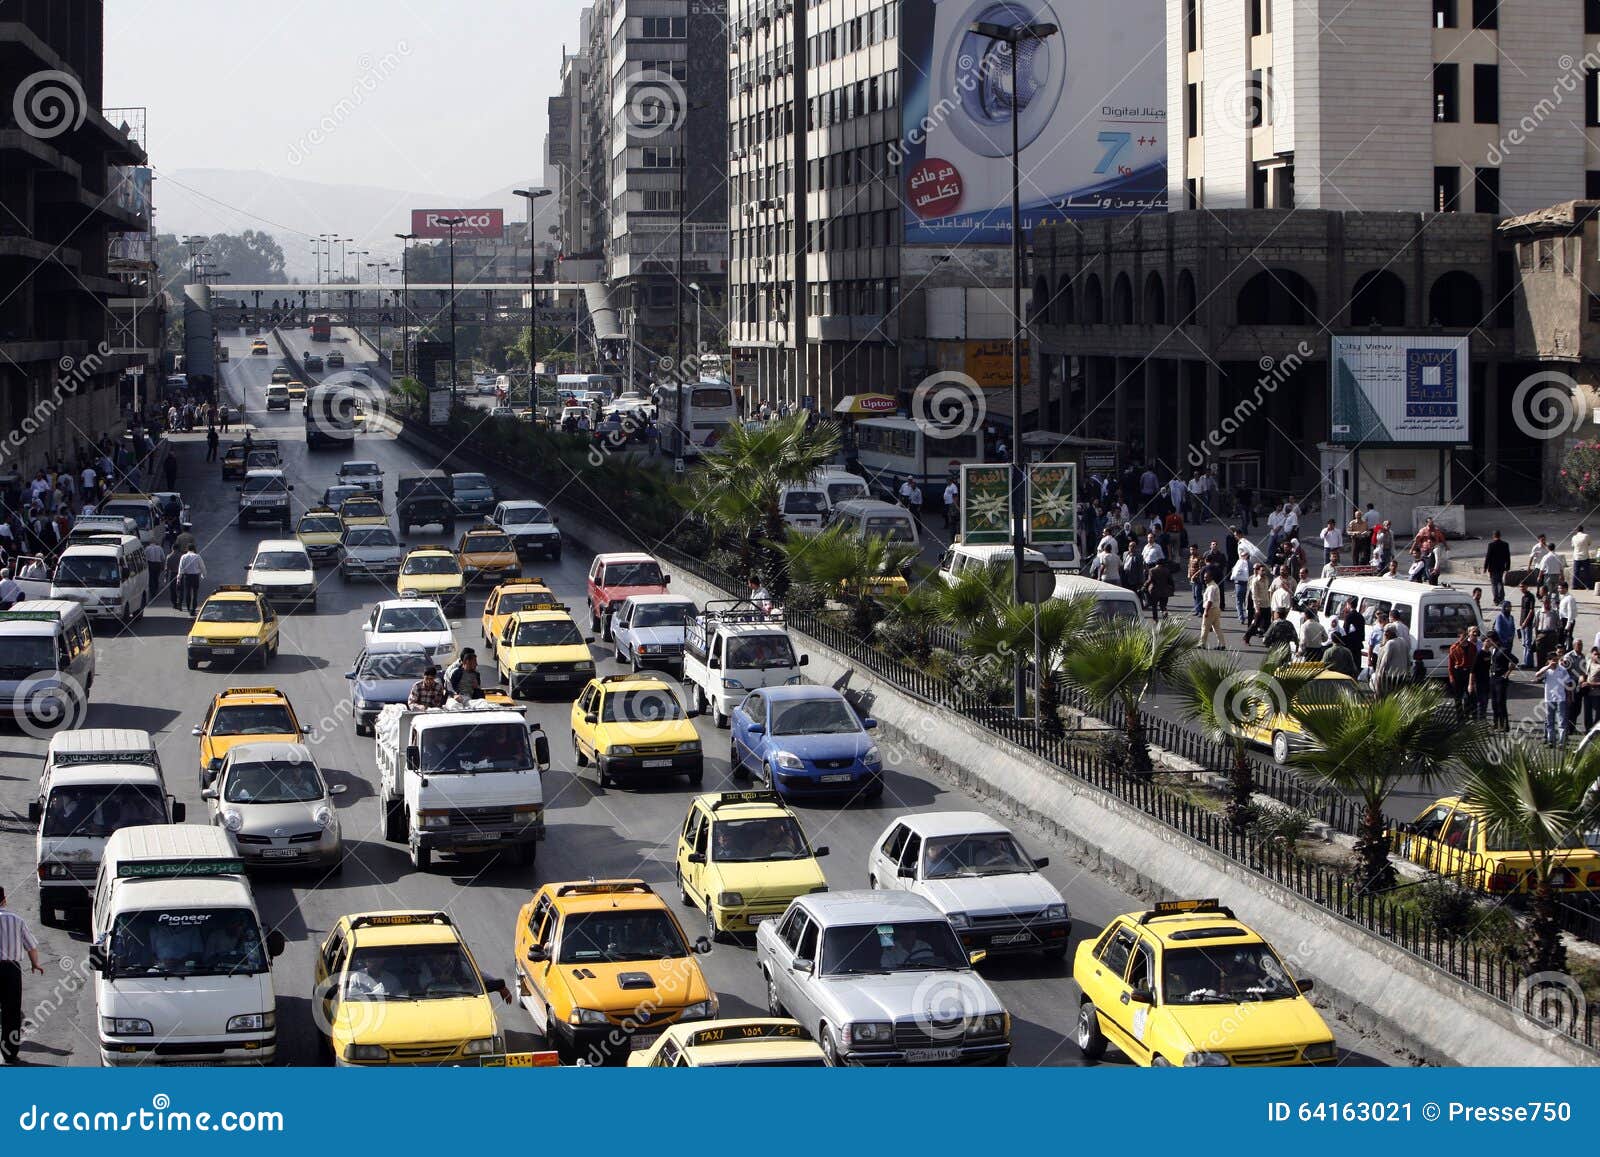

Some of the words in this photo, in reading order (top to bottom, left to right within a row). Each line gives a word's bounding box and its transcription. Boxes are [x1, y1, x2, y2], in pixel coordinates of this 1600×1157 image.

[1102, 106, 1139, 117] Digital
[1093, 131, 1131, 173] 7
[939, 167, 954, 181] مع
[1118, 165, 1132, 177] Kg
[911, 167, 936, 189] مانع
[916, 183, 960, 206] تكلس
[1056, 194, 1113, 209] وتار
[1114, 198, 1135, 209] من
[982, 218, 1032, 231] للوفير
[862, 401, 893, 409] Lipton
[1409, 405, 1453, 416] SYRIA
[1160, 903, 1177, 911] TAXI
[158, 914, 212, 922] Pioneer
[701, 1028, 724, 1041] TAXI
[743, 1028, 762, 1037] ١٥٥٩
[508, 1056, 531, 1066] ٤٦٩٠
